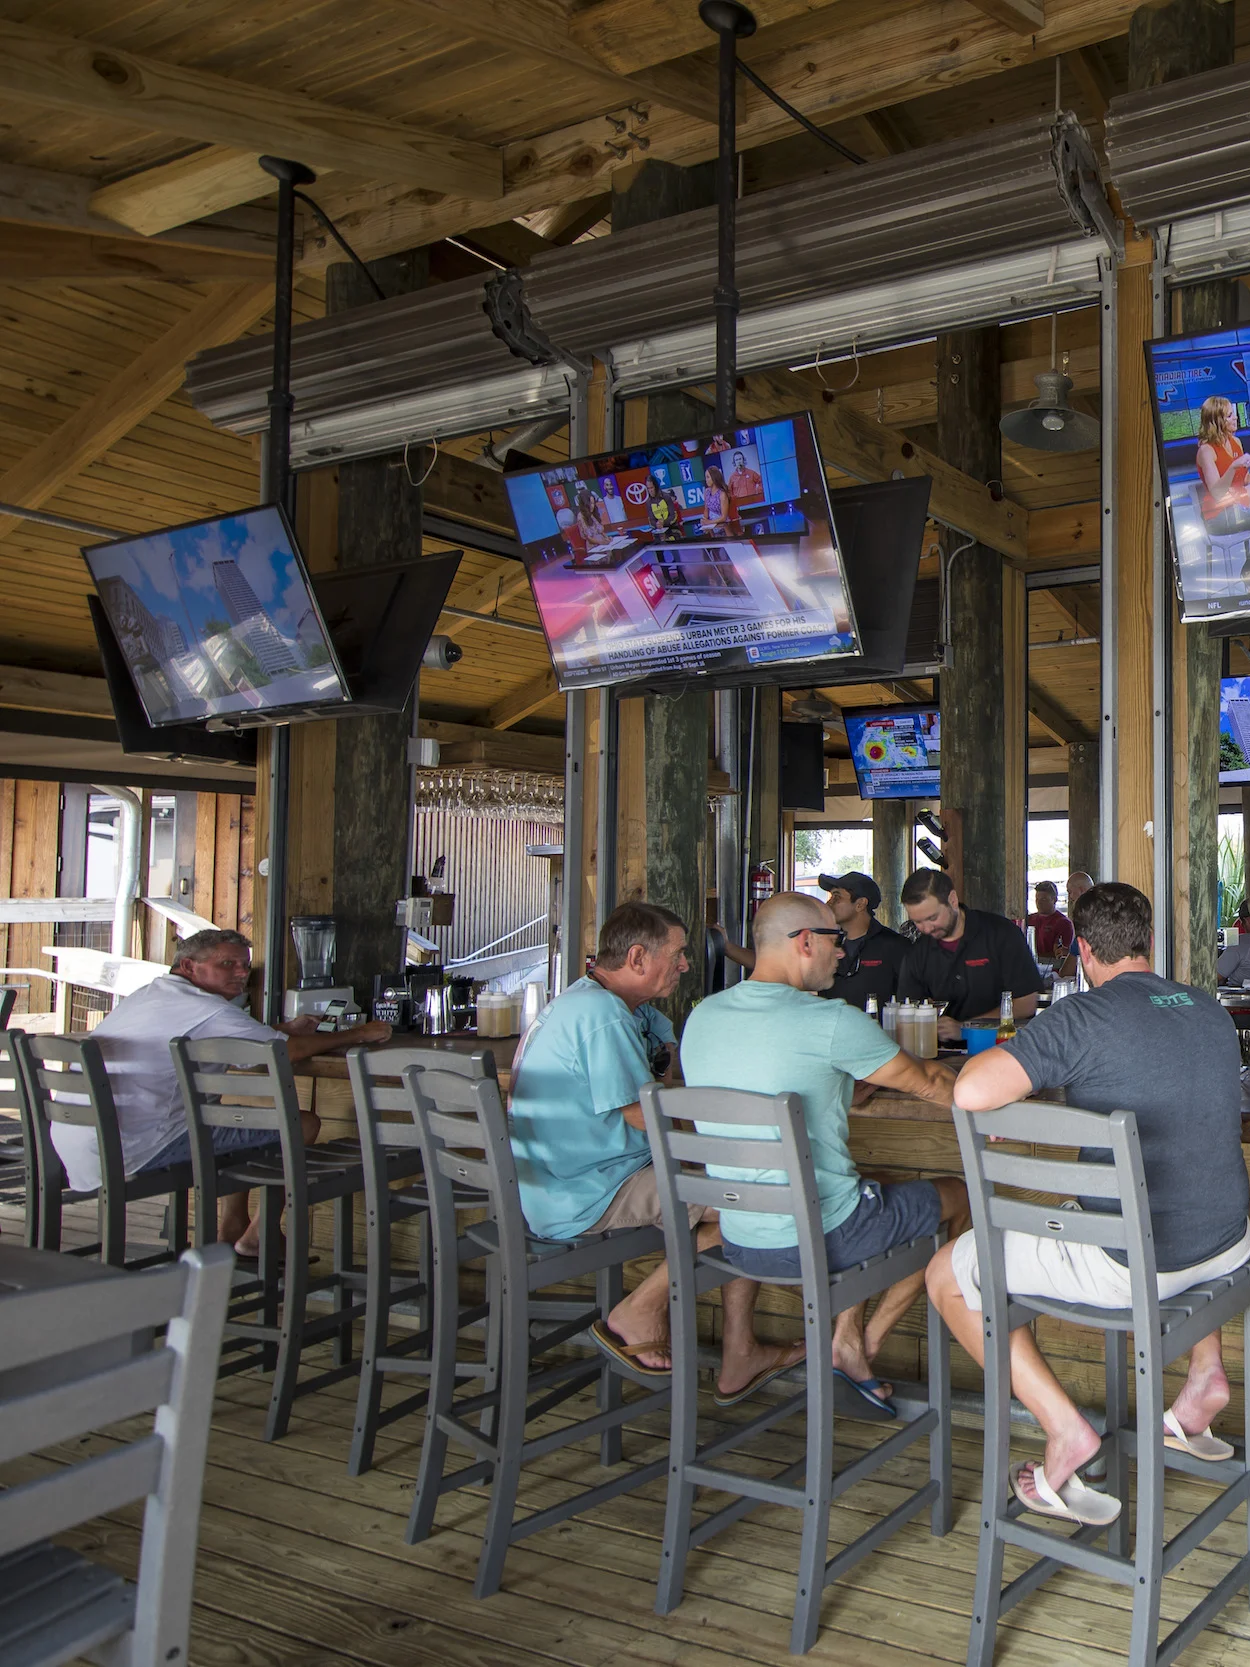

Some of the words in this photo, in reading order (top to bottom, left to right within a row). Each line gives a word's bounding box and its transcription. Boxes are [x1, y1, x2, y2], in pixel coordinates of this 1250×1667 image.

[1155, 370, 1186, 381] ANADIAN
[1187, 367, 1203, 378] TIRE
[687, 486, 706, 504] SN
[643, 571, 660, 597] SN
[1207, 602, 1221, 610] NFL
[606, 640, 624, 651] OHIO
[624, 635, 647, 649] STATE
[647, 632, 686, 646] SUSPENDS
[686, 628, 713, 641] URBAN
[714, 626, 739, 638] MEYER
[740, 624, 746, 633] 3
[746, 619, 774, 632] GAMES
[775, 618, 791, 628] FOR
[792, 615, 806, 625] HIS
[608, 648, 645, 660] HANDLING
[645, 646, 656, 656] OF
[657, 642, 681, 654] ABUSE
[682, 635, 732, 651] ALLEGATIONS
[733, 632, 765, 645] AGAINST
[767, 627, 799, 640] FORMER
[800, 623, 830, 635] COACH
